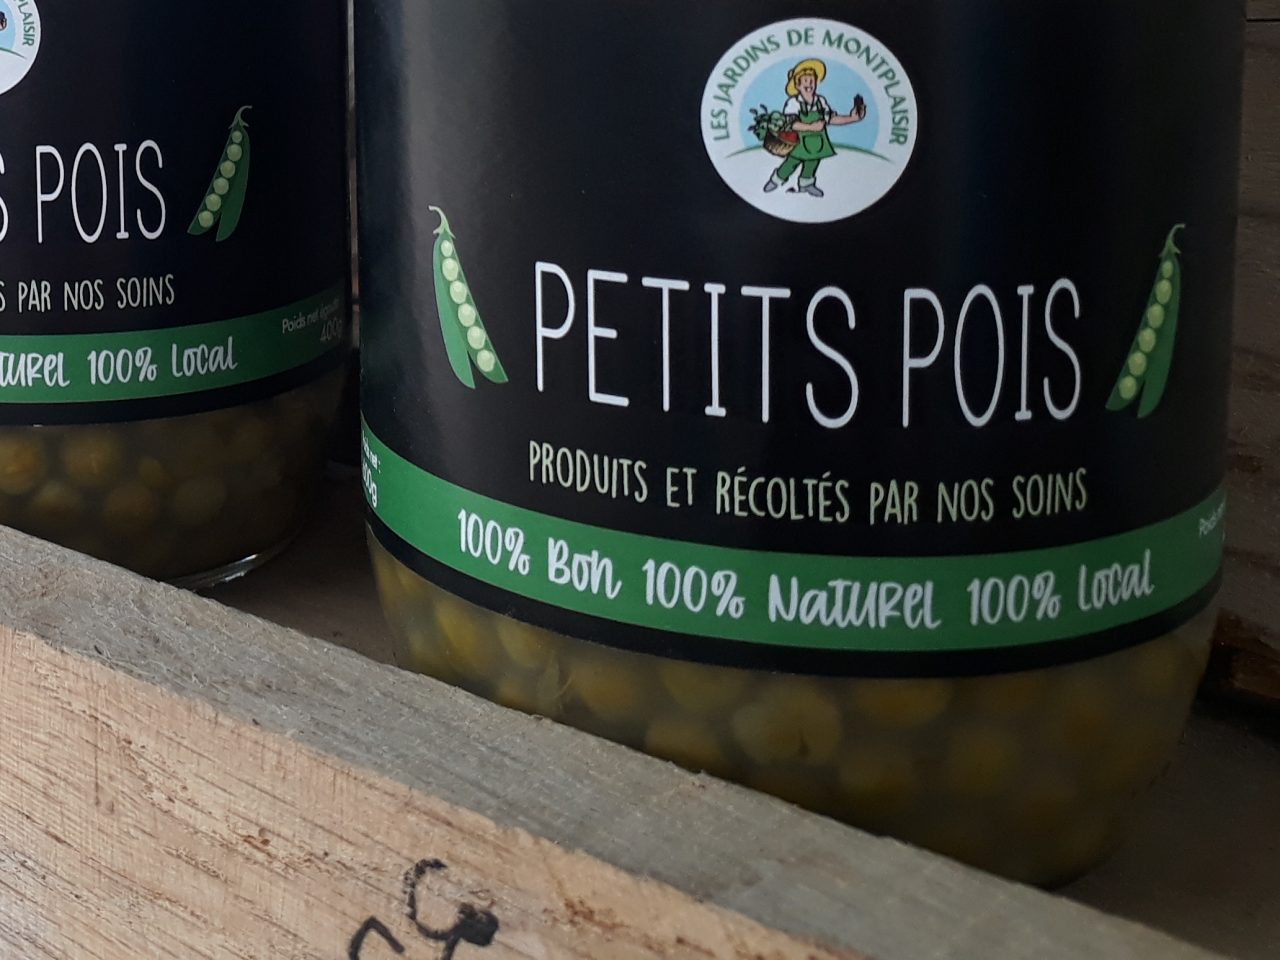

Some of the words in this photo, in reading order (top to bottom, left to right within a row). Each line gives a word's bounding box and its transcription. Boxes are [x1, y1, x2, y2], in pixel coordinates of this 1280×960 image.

[713, 34, 781, 106] JARDINS
[786, 27, 815, 47] DE
[822, 29, 910, 146] MONTPLAISIR
[711, 107, 731, 142] LES
[35, 139, 167, 245] POIS
[18, 279, 51, 313] PAR
[63, 278, 105, 311] NOS
[117, 273, 176, 310] SOINS
[282, 311, 306, 334] Poids
[87, 346, 159, 386] 100%
[171, 335, 239, 378] Local
[534, 260, 860, 429] PETITS
[902, 277, 1082, 428] POIS
[528, 439, 649, 503] PRODUITS
[666, 467, 698, 508] ET
[715, 466, 851, 524] RÉCOLTÉS
[869, 478, 919, 526] PAR
[936, 477, 995, 524] NOS
[1012, 466, 1088, 520] SOINS
[457, 508, 531, 577] 100%
[547, 537, 622, 600] Bon
[642, 558, 746, 620] 100%
[966, 569, 1063, 626] 100%
[1077, 548, 1155, 612] Local
